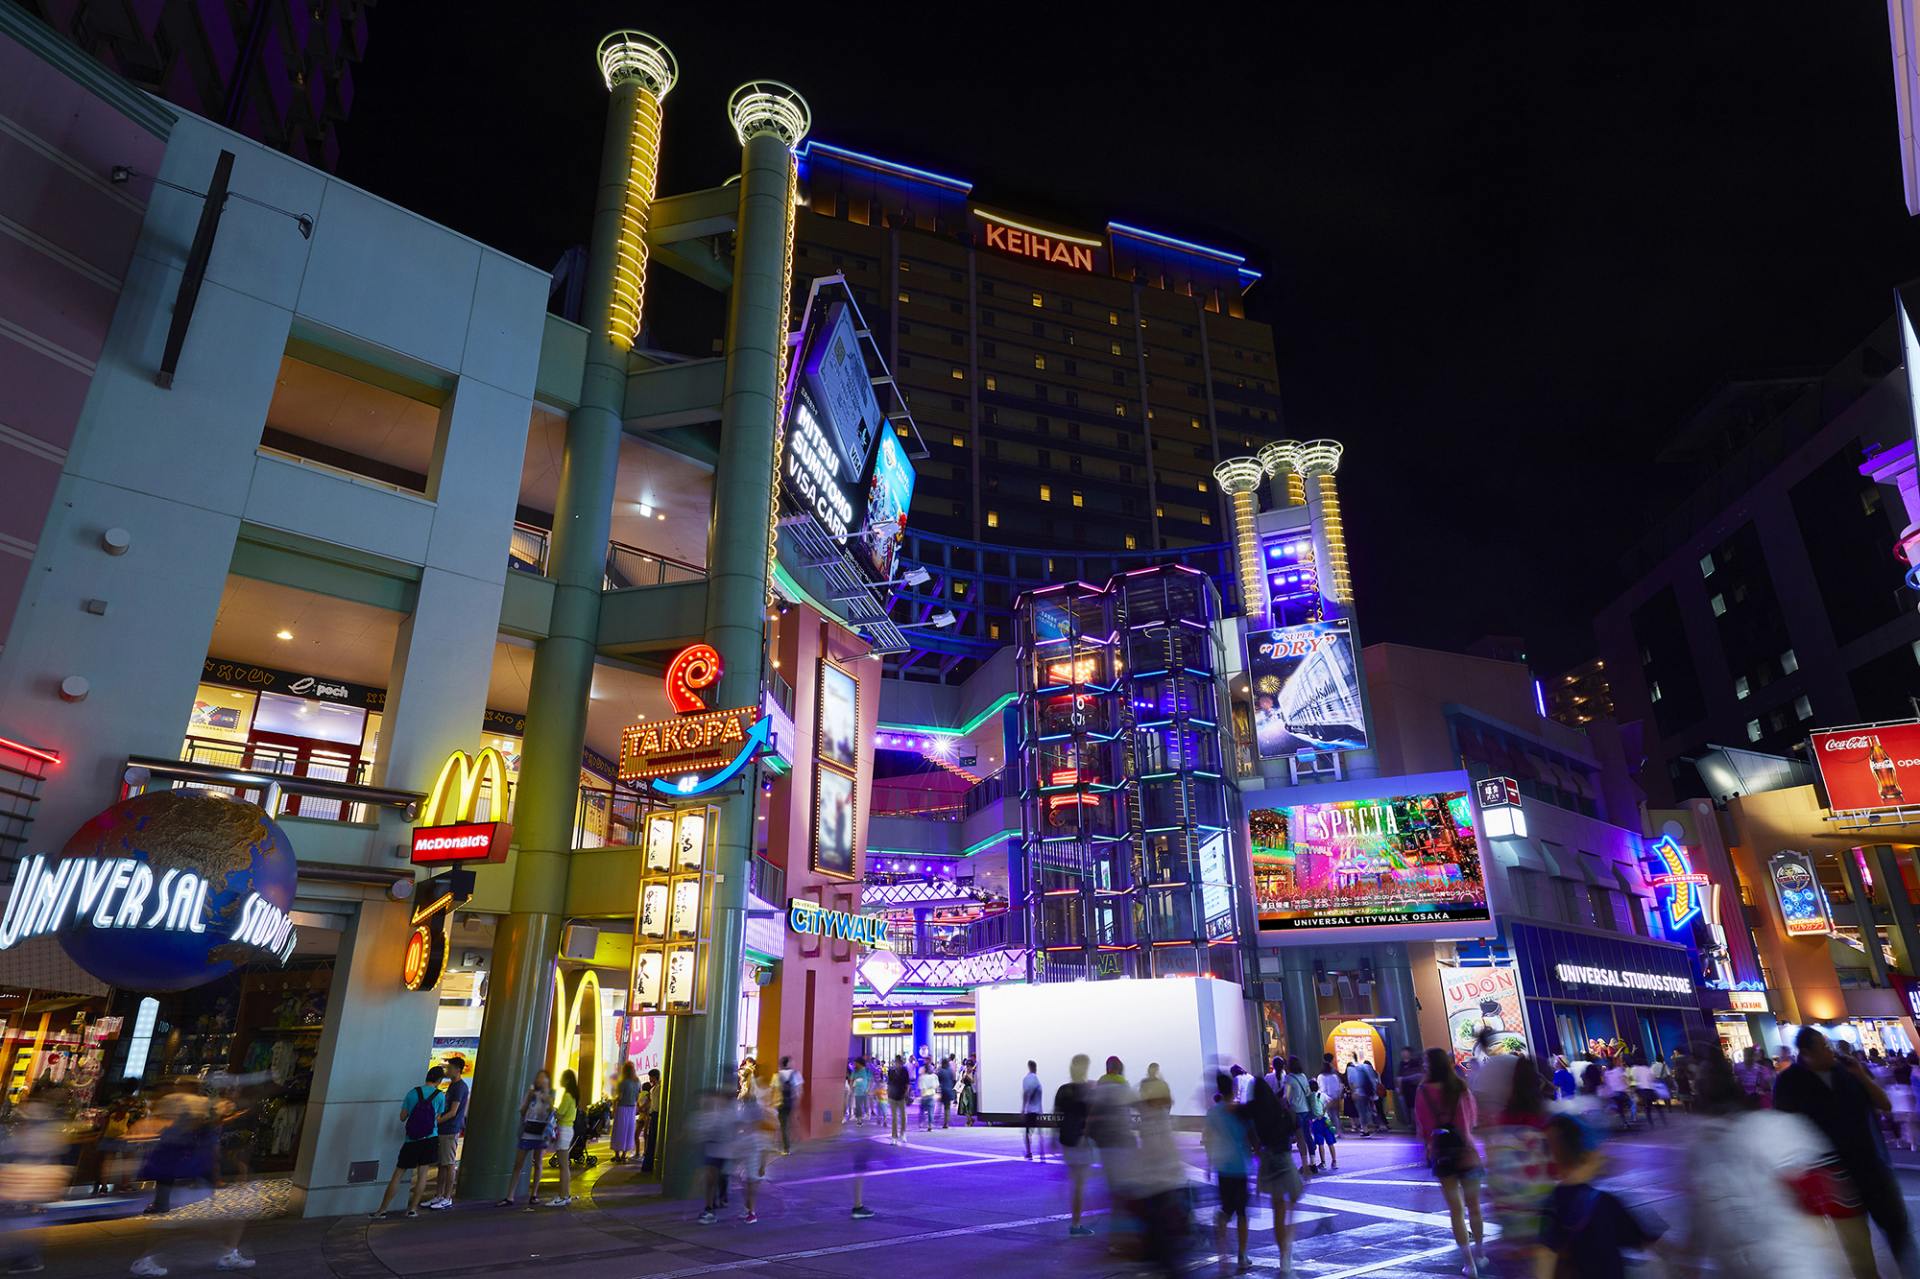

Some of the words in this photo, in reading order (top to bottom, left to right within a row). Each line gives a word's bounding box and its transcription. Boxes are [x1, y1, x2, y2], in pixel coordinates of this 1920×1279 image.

[987, 224, 1092, 271] KEIHAN
[797, 404, 840, 478] MITSUI
[792, 430, 853, 524] SUMITOMO
[788, 454, 817, 508] VISA
[816, 494, 848, 545] CARD
[628, 716, 744, 757] TAKOPA
[1825, 736, 1869, 751] Coca-Cola
[1318, 805, 1399, 840] SPECTA
[415, 834, 489, 852] McDonald's
[0, 853, 207, 950] UNIVERSAL
[1294, 917, 1351, 927] UNIVERSAL
[1354, 914, 1408, 924] CITYWALK
[1412, 912, 1450, 920] OSAKA
[791, 907, 890, 946] CITYWALK
[1448, 972, 1513, 1002] UDON
[1557, 964, 1622, 987] UNIVERSAL
[1621, 971, 1664, 991] STUDIOS
[1663, 976, 1692, 994] STORE
